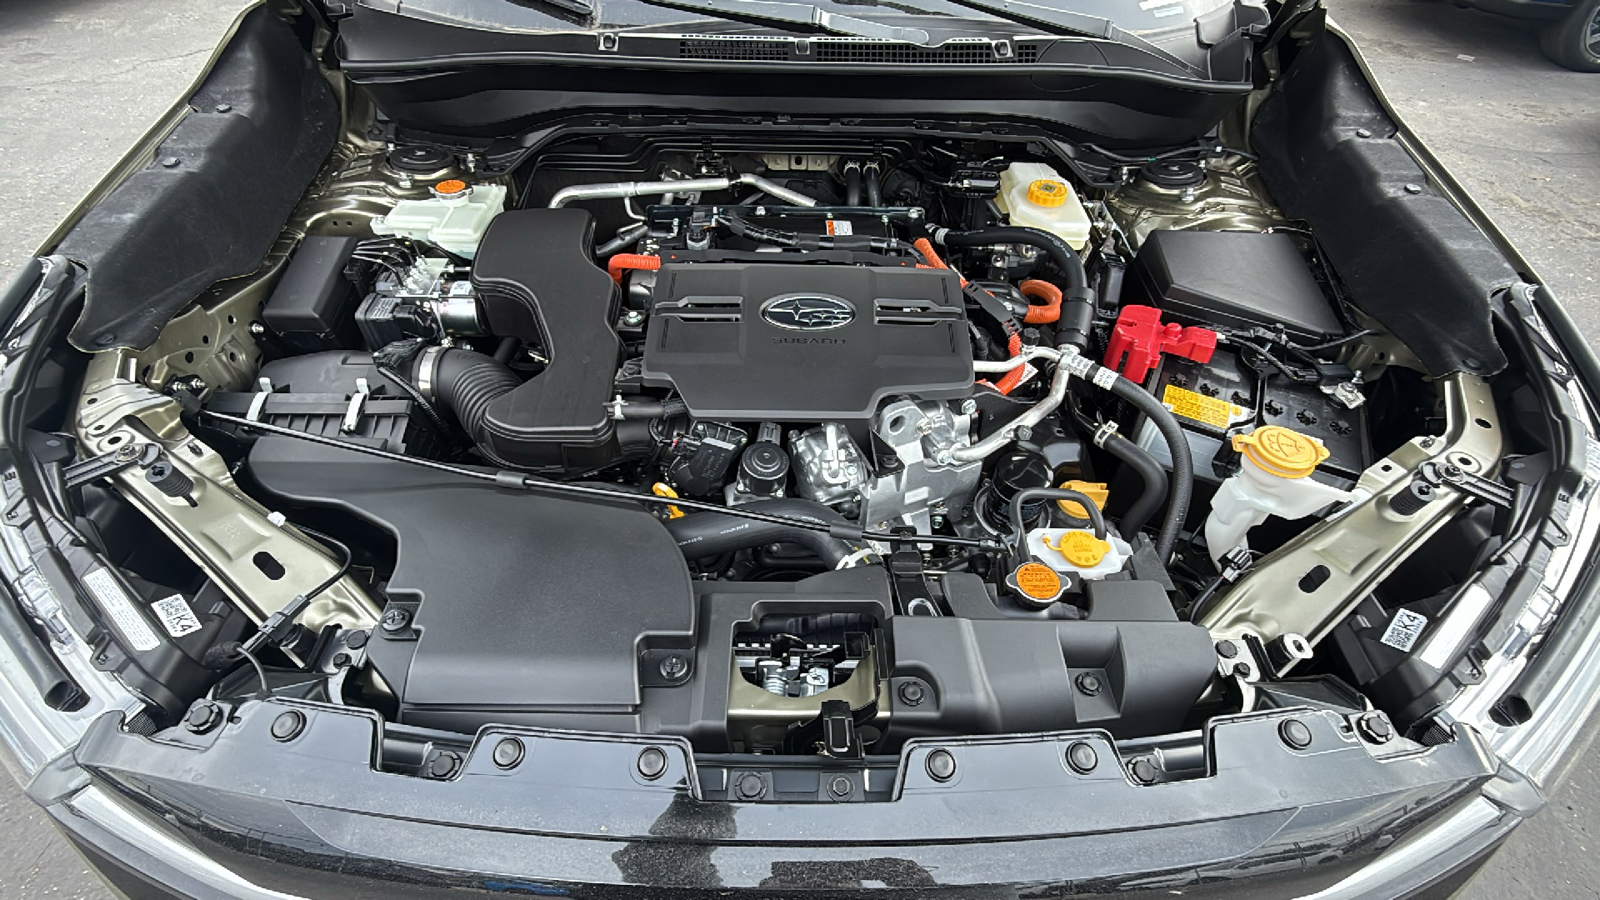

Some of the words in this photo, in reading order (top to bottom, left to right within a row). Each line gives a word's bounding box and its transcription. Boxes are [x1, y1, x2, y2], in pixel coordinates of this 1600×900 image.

[772, 337, 846, 345] SUBARU
[172, 614, 193, 632] K4
[1399, 612, 1420, 630] K4
